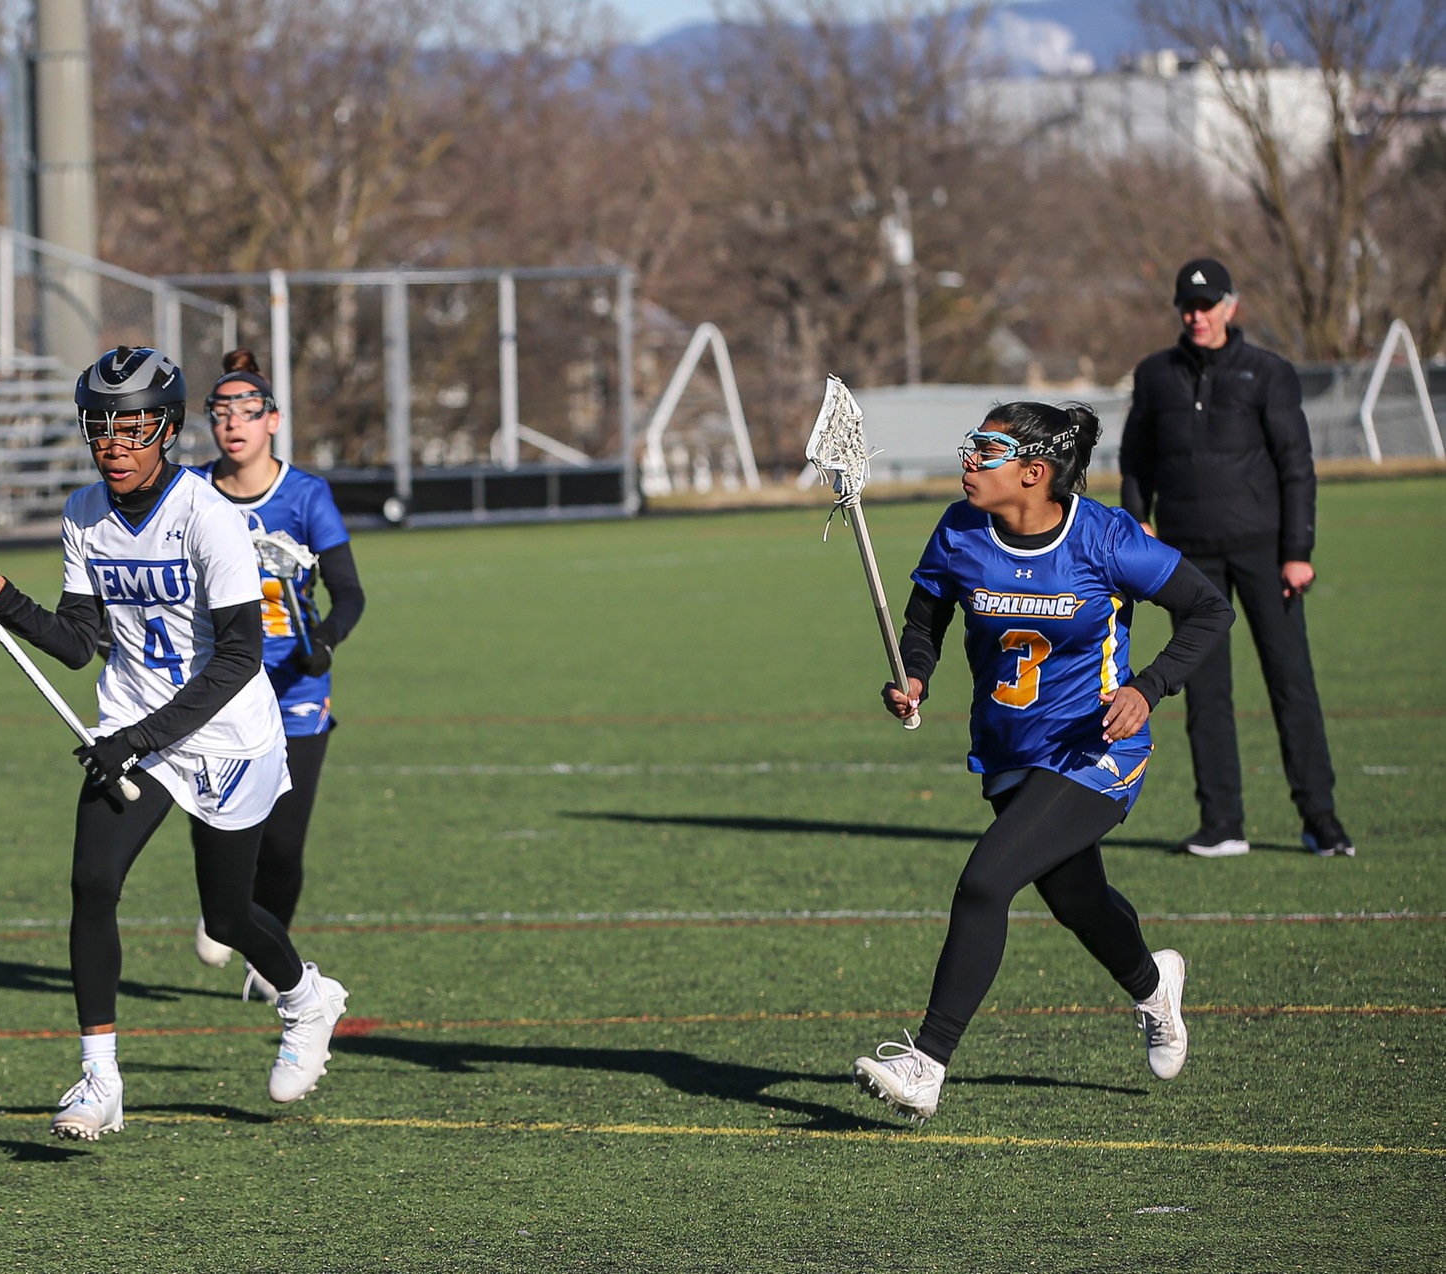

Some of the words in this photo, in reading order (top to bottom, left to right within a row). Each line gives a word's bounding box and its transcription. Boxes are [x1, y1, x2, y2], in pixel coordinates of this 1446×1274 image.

[1017, 440, 1045, 456] STX
[93, 565, 187, 602] EMU
[973, 591, 1077, 616] SPALDING
[143, 616, 185, 685] 4
[991, 628, 1053, 710] 3
[121, 753, 140, 771] STX
